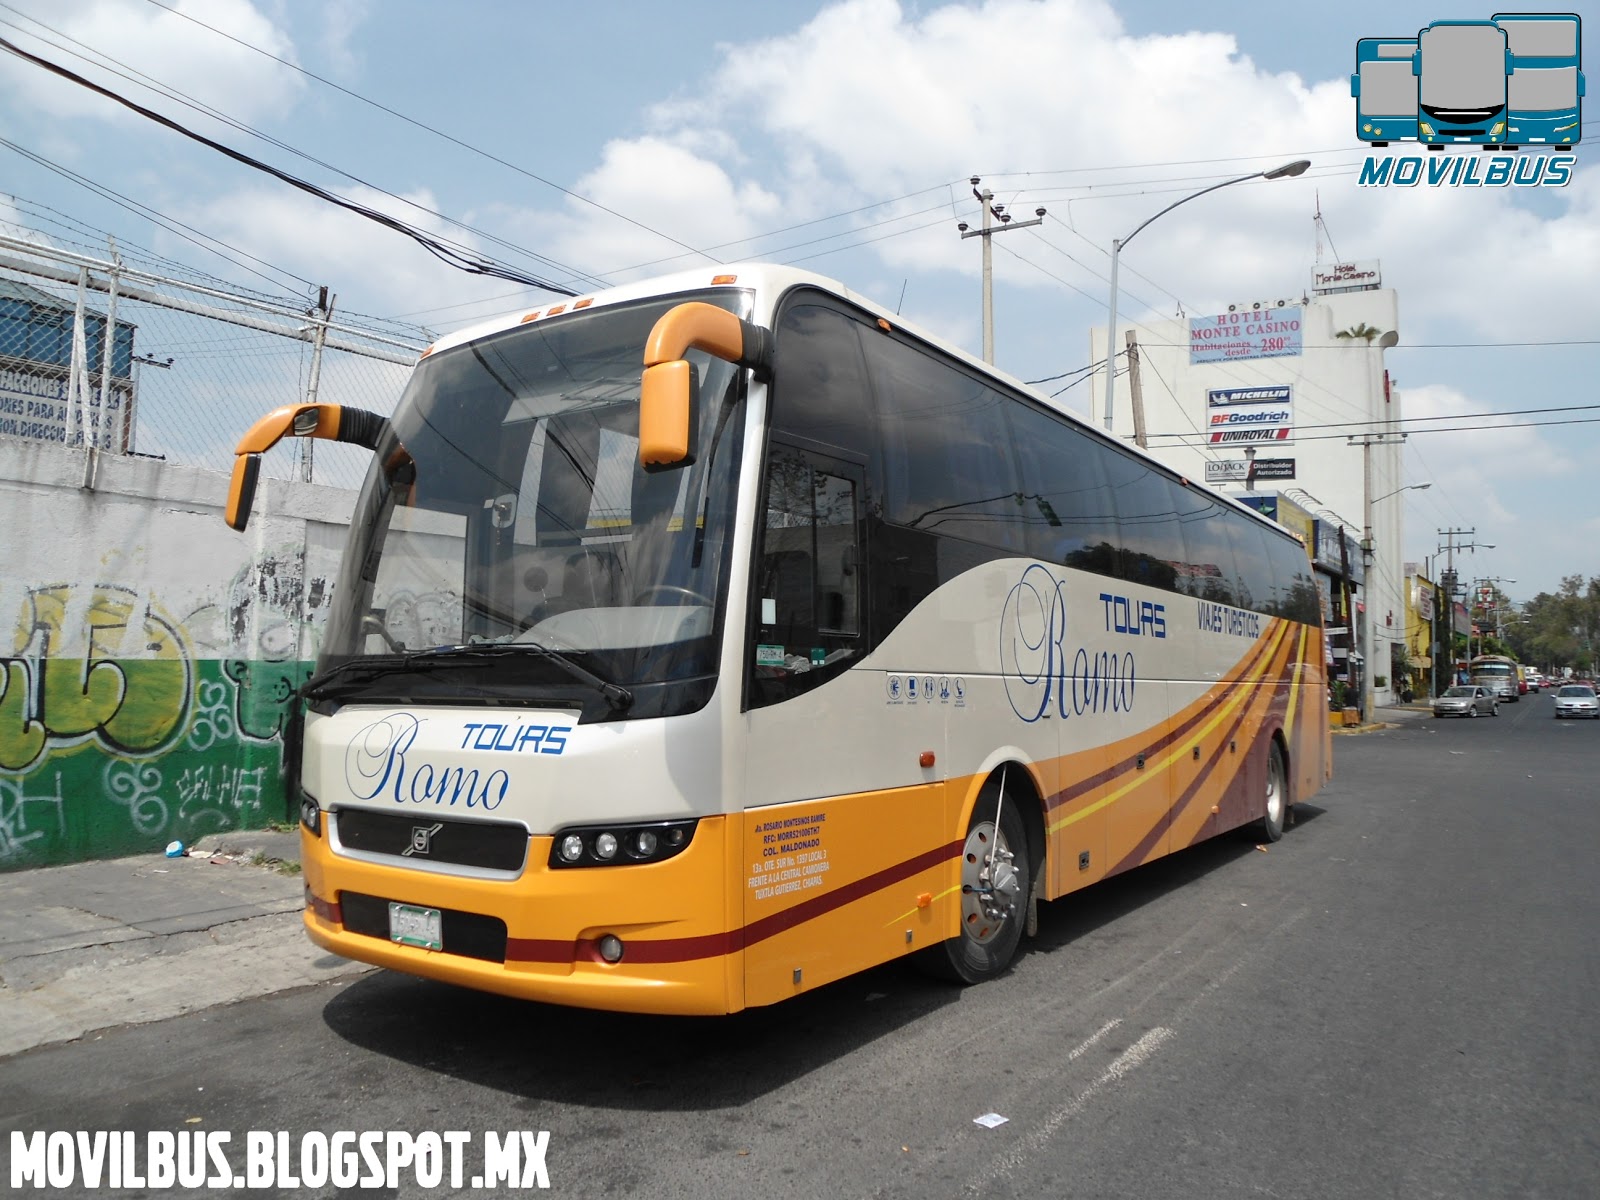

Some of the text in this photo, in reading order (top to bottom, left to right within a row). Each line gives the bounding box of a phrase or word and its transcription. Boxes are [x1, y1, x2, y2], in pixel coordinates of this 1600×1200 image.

[1217, 310, 1273, 325] HOTEL
[1191, 320, 1300, 340] MONTE CASINO
[1192, 341, 1251, 352] Habitaciones
[1225, 347, 1251, 356] desde
[1230, 390, 1289, 400] MICHELIN
[27, 401, 54, 419] PARA
[1211, 411, 1289, 423] BFGoodrich
[1222, 429, 1275, 442] UNIROYAL
[1099, 593, 1165, 638] TOURS
[1198, 601, 1259, 639] VIAJES TURISTICOS
[461, 723, 572, 755] TOURS
[763, 820, 782, 832] ROSARIO
[763, 838, 820, 857] COL. MALDONADO
[776, 857, 787, 869] SUR
[808, 851, 823, 862] LOCAL
[748, 875, 767, 888] FRENTE
[773, 872, 780, 882] LA
[780, 869, 801, 881] CENTRAL
[802, 861, 830, 876] CAMIONERA
[755, 886, 774, 900] TUXTLA
